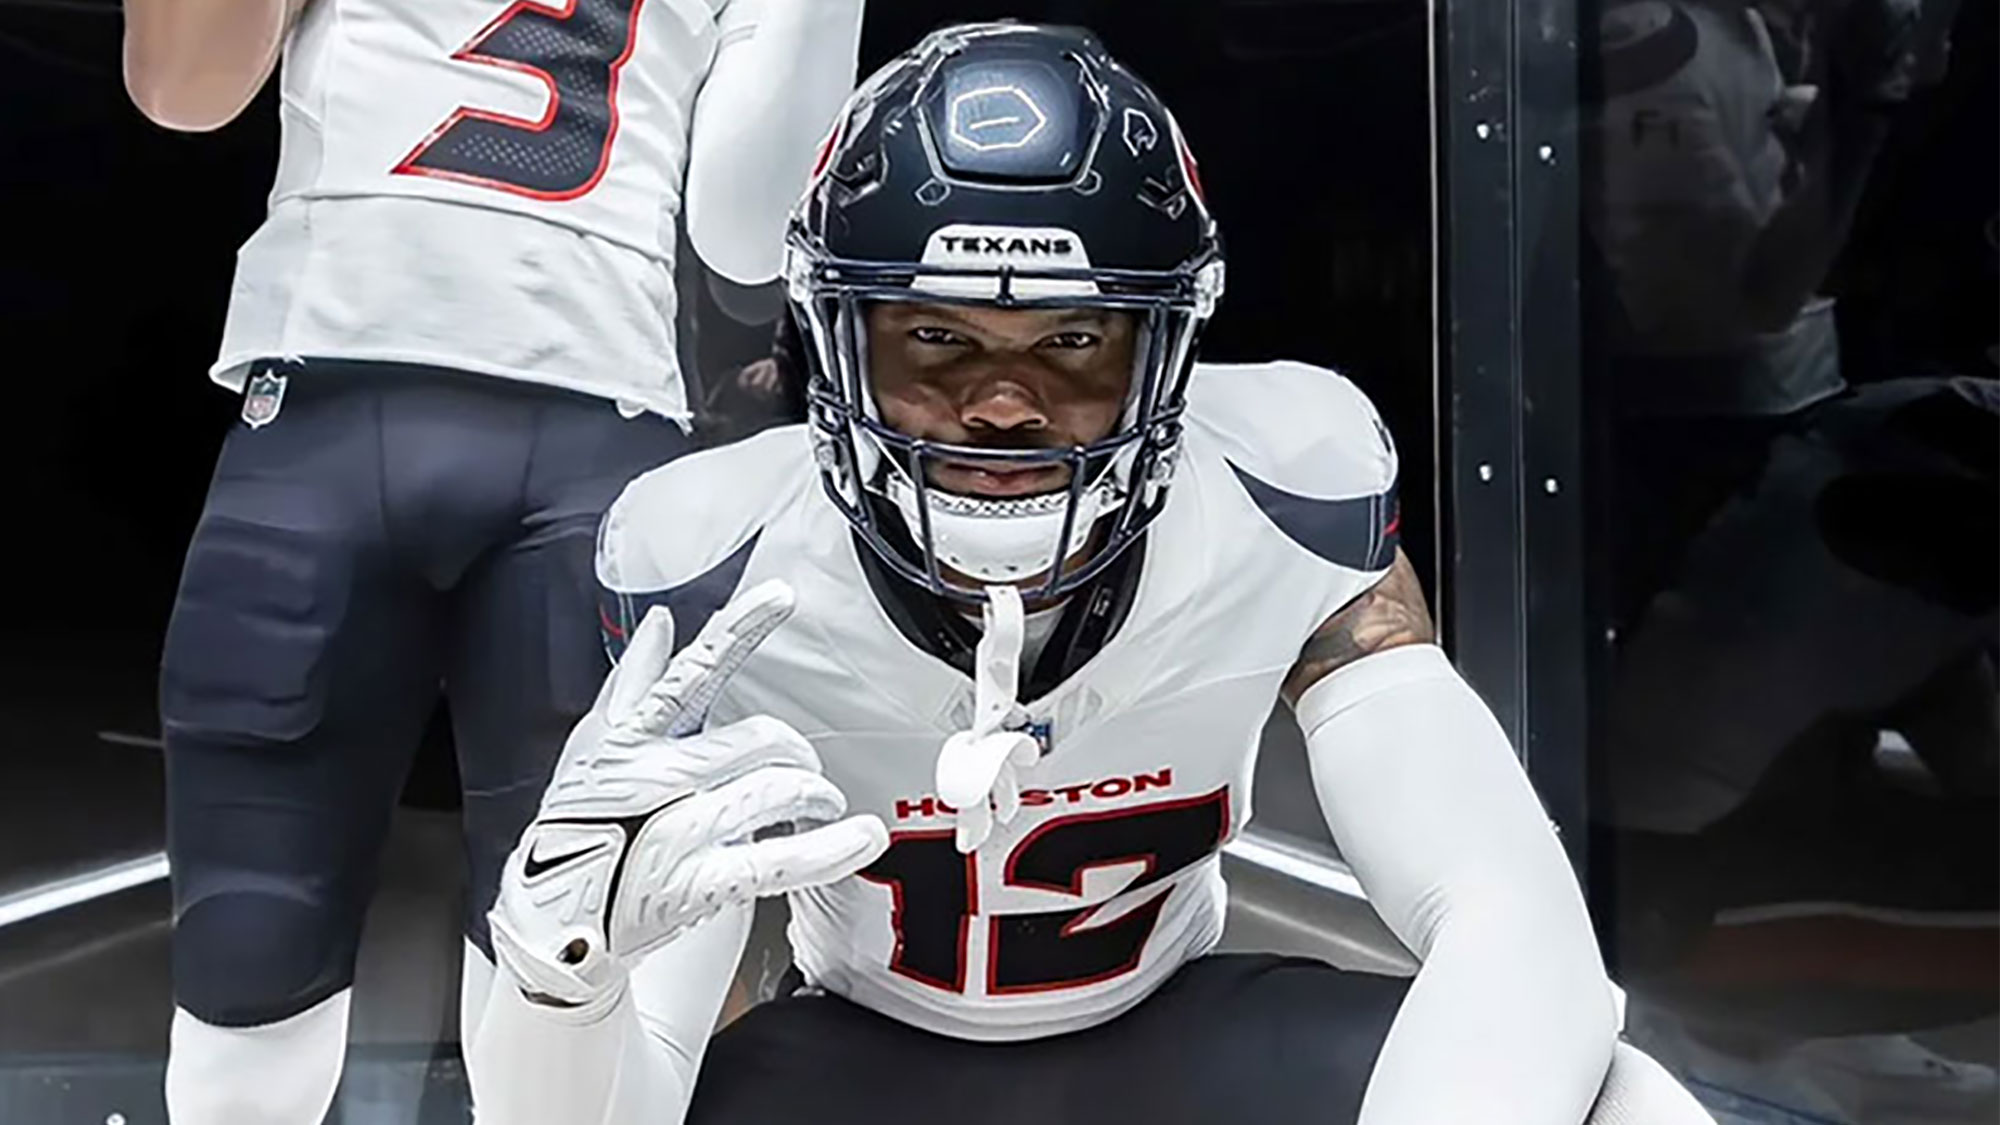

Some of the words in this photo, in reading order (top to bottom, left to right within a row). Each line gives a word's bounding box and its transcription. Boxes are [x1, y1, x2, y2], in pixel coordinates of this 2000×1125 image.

[939, 235, 1073, 255] TEXANS
[894, 767, 1173, 819] HSTON
[856, 784, 1231, 996] 12
